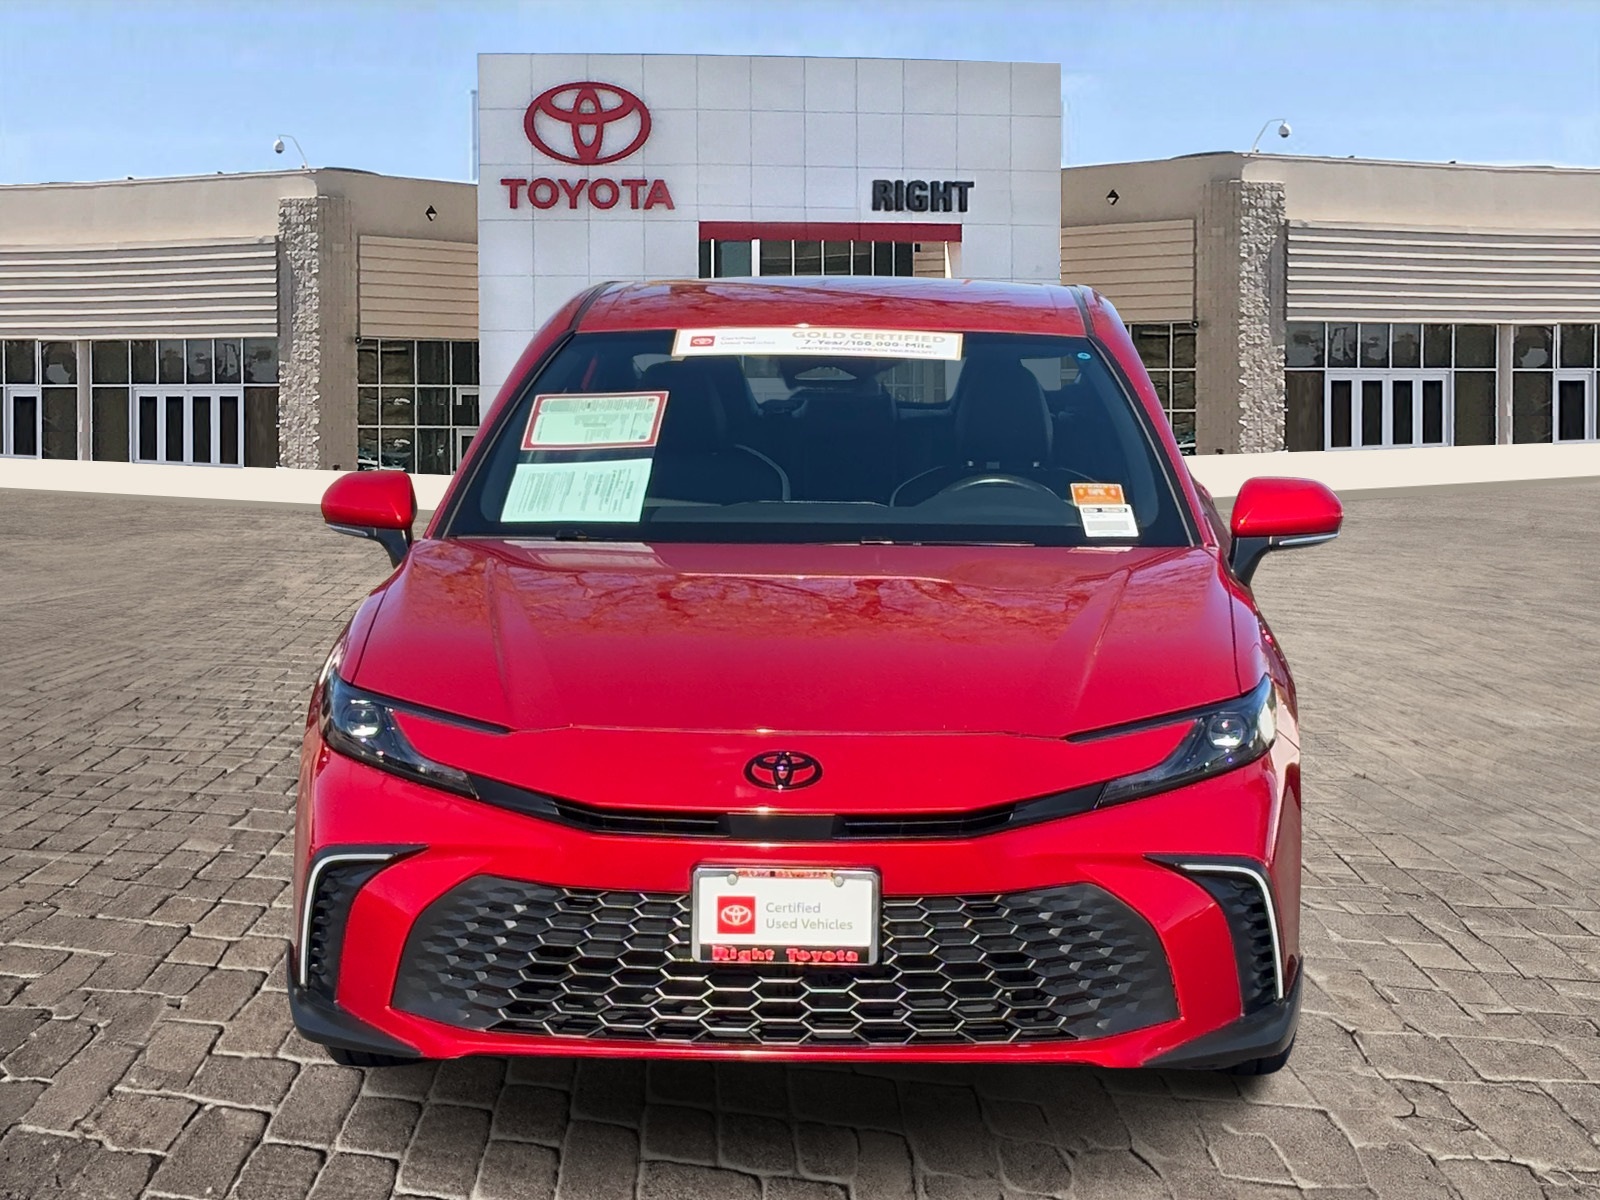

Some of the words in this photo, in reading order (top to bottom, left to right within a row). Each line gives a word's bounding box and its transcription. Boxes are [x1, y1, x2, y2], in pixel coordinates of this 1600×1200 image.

[500, 178, 675, 210] TOYOTA
[871, 179, 975, 213] RIGHT
[792, 331, 846, 339] GOLD
[850, 333, 946, 343] CERTIFIED
[765, 902, 821, 914] Certified
[765, 918, 798, 929] Used
[801, 918, 853, 930] Vehicles
[711, 946, 775, 961] Right
[786, 948, 858, 962] Toyota
